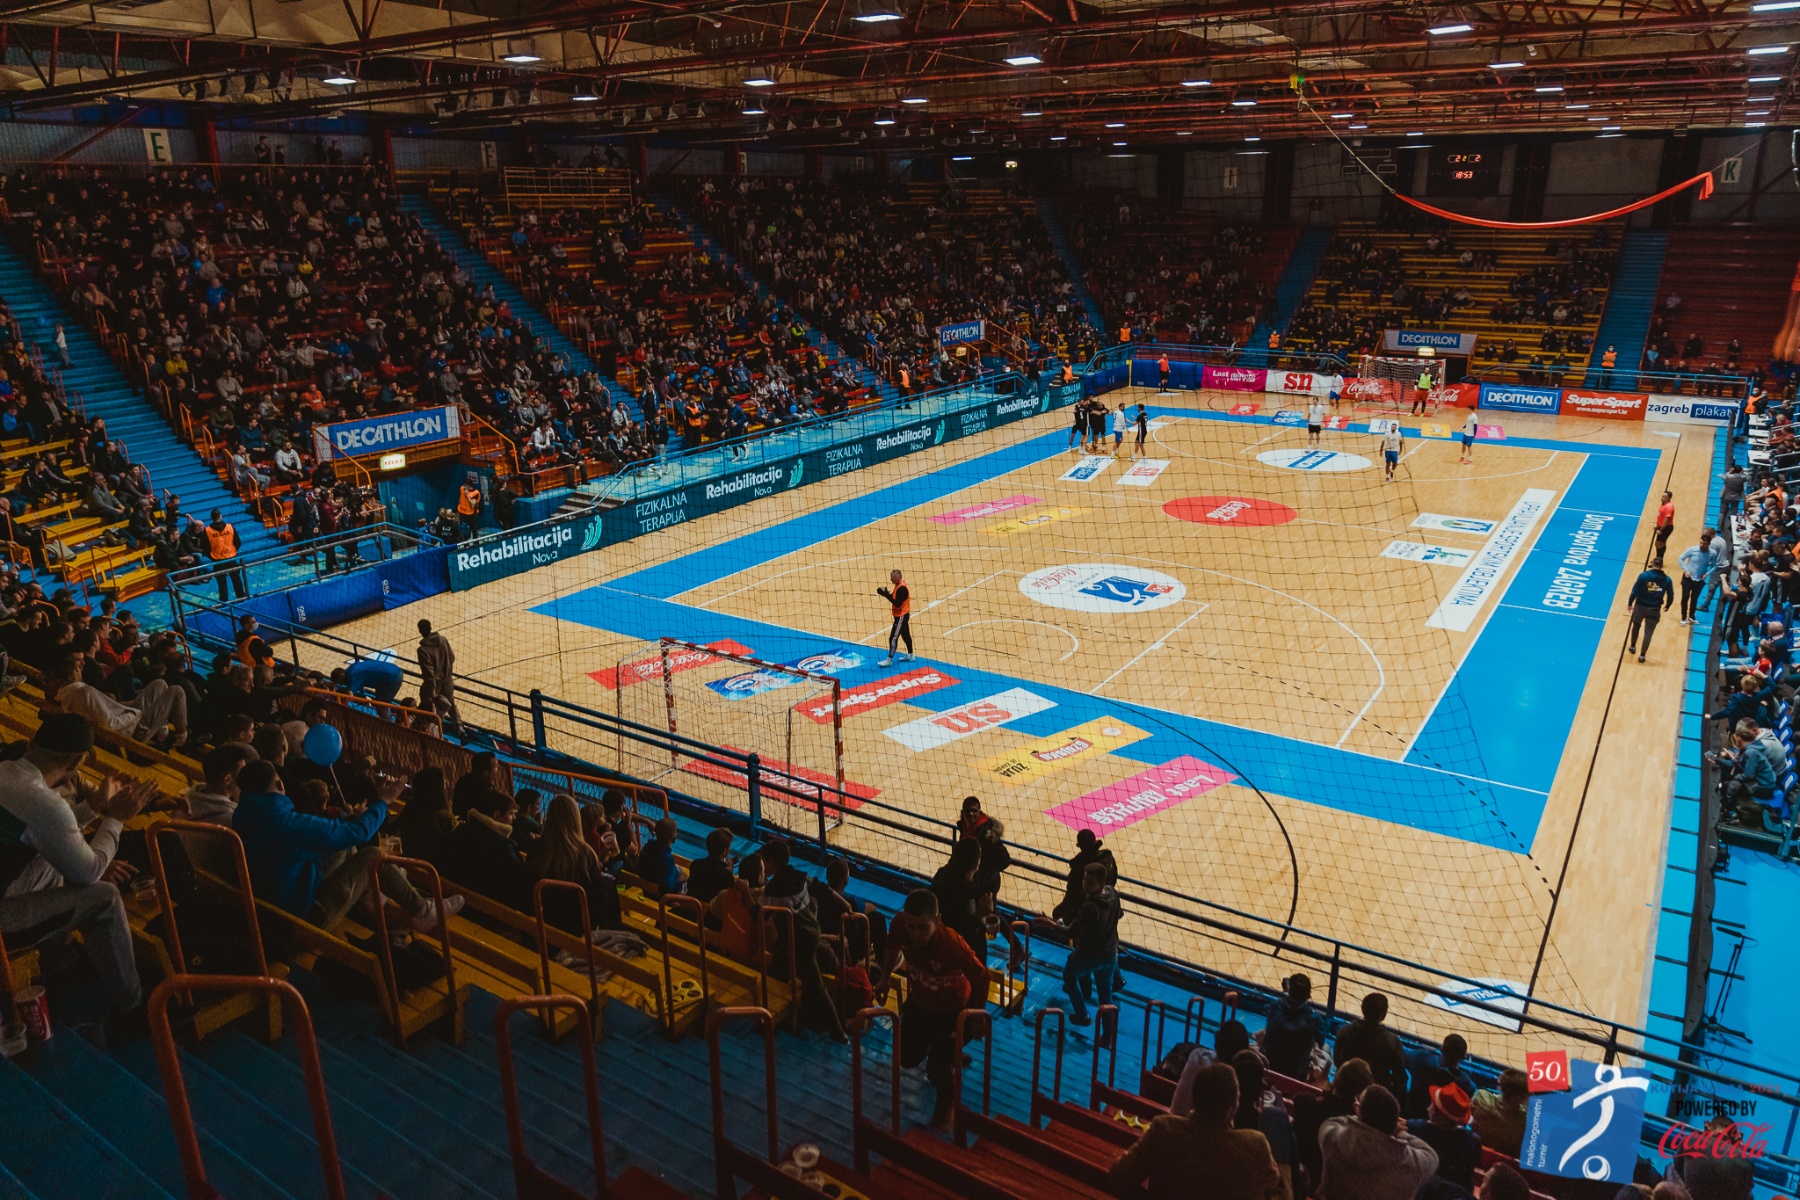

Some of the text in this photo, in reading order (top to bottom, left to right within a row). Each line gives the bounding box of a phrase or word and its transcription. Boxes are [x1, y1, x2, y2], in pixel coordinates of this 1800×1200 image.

[150, 132, 166, 162] E
[1725, 160, 1739, 181] K
[943, 325, 978, 342] DECATHLON
[1401, 334, 1457, 346] DECATHLON
[1284, 372, 1313, 391] sn
[997, 395, 1040, 416] Rehabilitacija
[1488, 392, 1552, 406] DECATHLON
[1566, 394, 1642, 409] SuperSport
[961, 409, 988, 424] FIZIKALNA
[1647, 404, 1689, 415] zagreb
[1695, 406, 1734, 418] plakat
[336, 415, 442, 450] DECATHLON
[876, 421, 931, 451] Rehabilitacija
[962, 421, 986, 437] TERAPIJA
[825, 443, 864, 463] FIZIKALNA
[910, 441, 924, 451] Nova
[828, 457, 862, 477] TERAPIJA
[706, 467, 783, 500] Rehabilitacija
[754, 486, 772, 498] Nova
[635, 493, 688, 518] FIZIKALNA
[639, 509, 686, 533] TERAPIJA
[456, 525, 573, 571] Rehabilitacija
[532, 550, 558, 565] Nova
[1542, 513, 1614, 610] Dom sportova ZAGREB
[1451, 567, 1498, 607] OBJEKTIMA
[931, 702, 1012, 734] sn
[999, 761, 1031, 778] ŽUJA
[1092, 774, 1216, 826] Last minute
